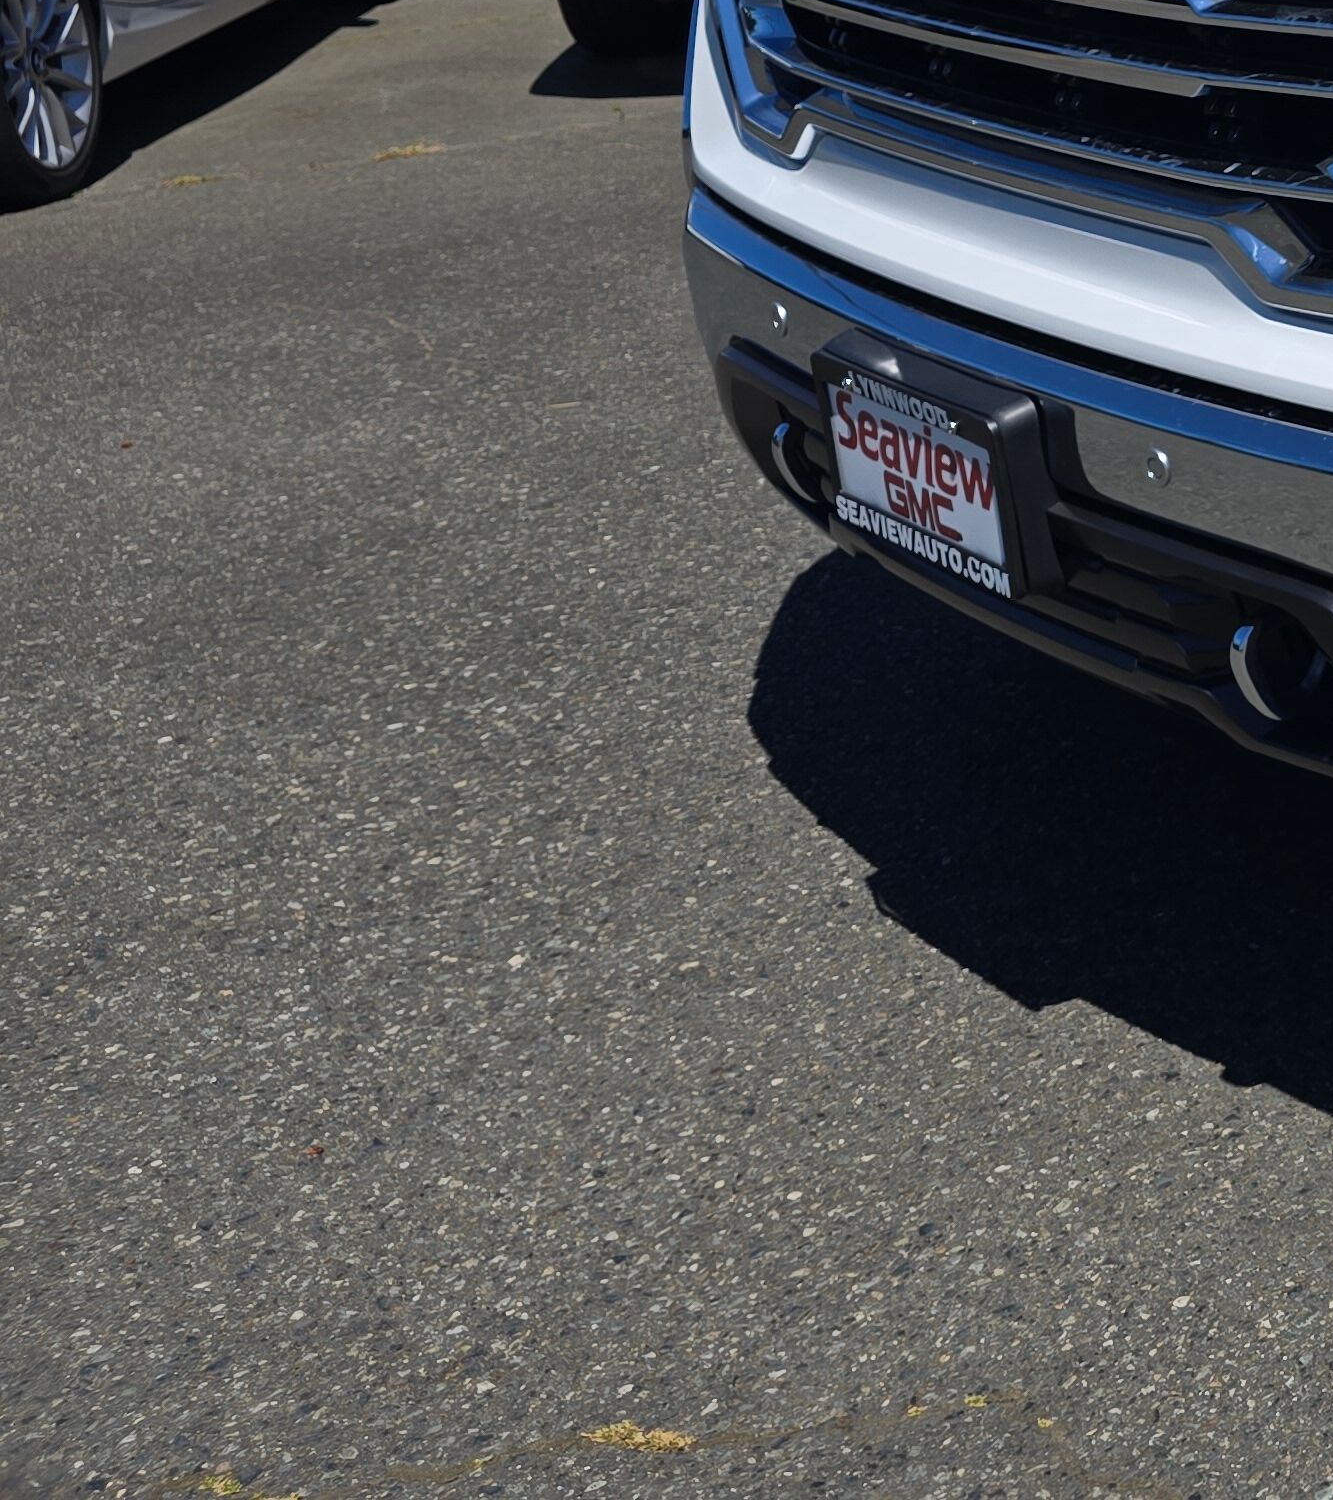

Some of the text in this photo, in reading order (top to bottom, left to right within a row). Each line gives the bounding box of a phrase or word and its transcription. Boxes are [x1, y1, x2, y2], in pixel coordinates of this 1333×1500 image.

[848, 371, 950, 429] LYNNWOOD
[836, 390, 996, 511] Seaview
[836, 495, 1012, 599] SEAVIEWAUTO.COM
[884, 470, 963, 543] GMC
